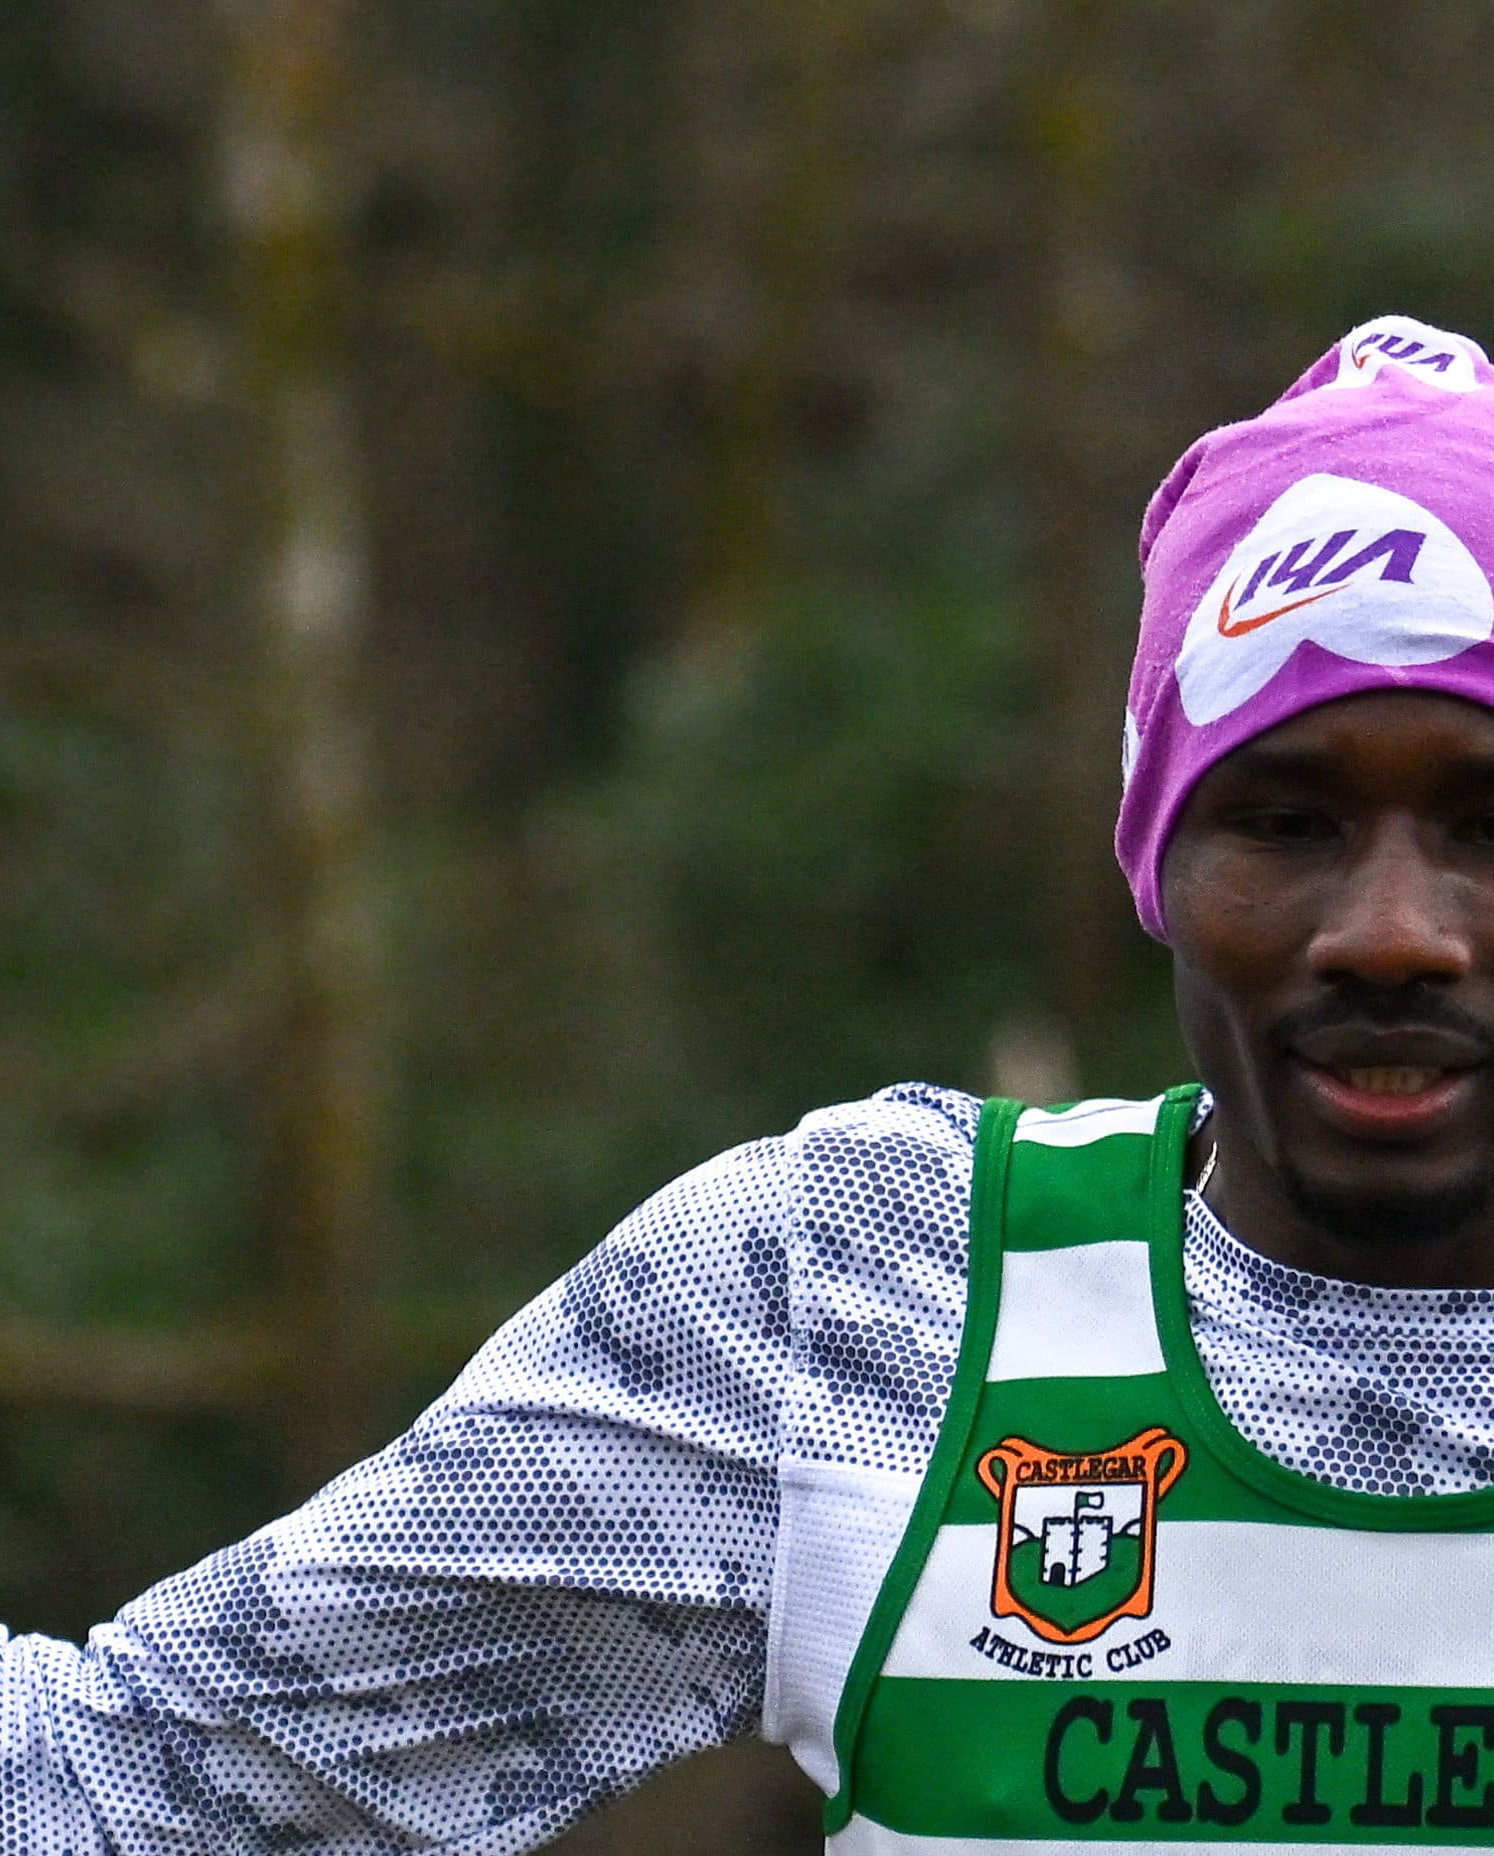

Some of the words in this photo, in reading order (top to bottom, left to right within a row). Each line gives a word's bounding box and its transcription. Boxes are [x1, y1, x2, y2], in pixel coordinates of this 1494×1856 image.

[1015, 1455, 1147, 1482] CASTLEGAR
[970, 1626, 1093, 1679] ATHLETIC
[1106, 1629, 1172, 1673] CLUB
